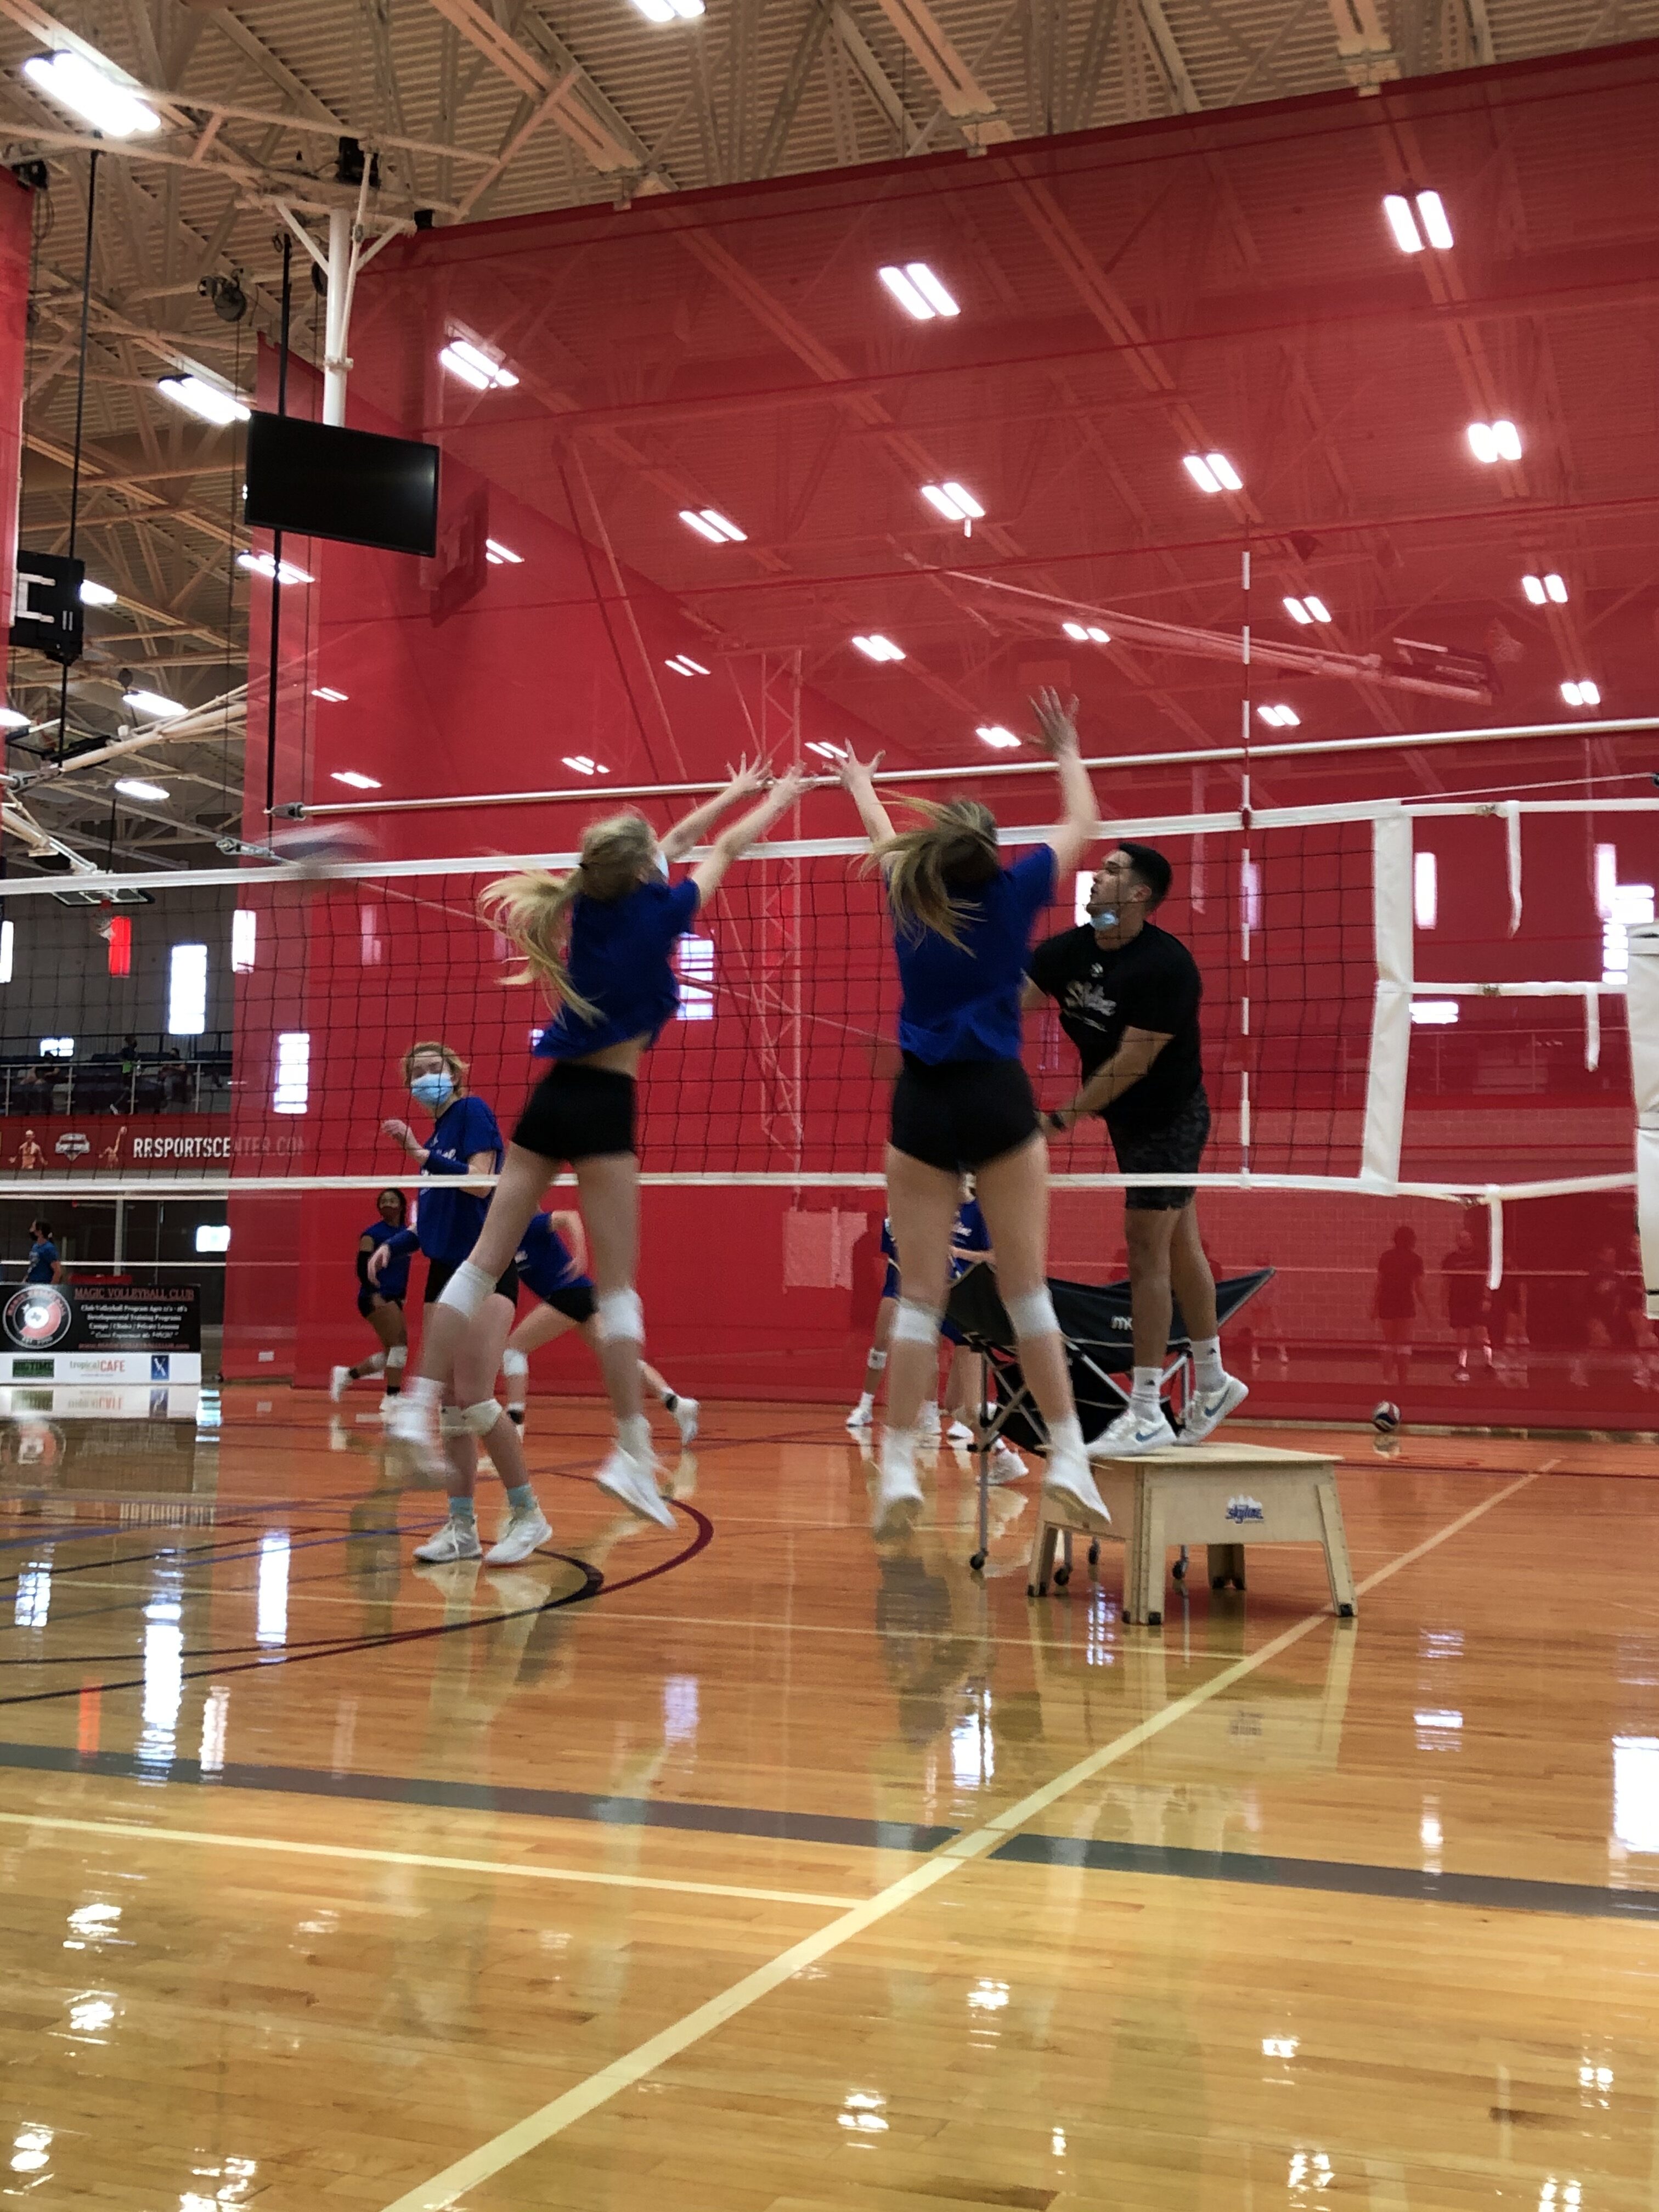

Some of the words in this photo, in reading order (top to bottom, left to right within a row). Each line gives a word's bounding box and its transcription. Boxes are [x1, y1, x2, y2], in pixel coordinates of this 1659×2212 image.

[75, 1288, 105, 1300] MAGIC
[108, 1288, 165, 1300] VOLLEYBALL
[168, 1288, 194, 1301] CLUB
